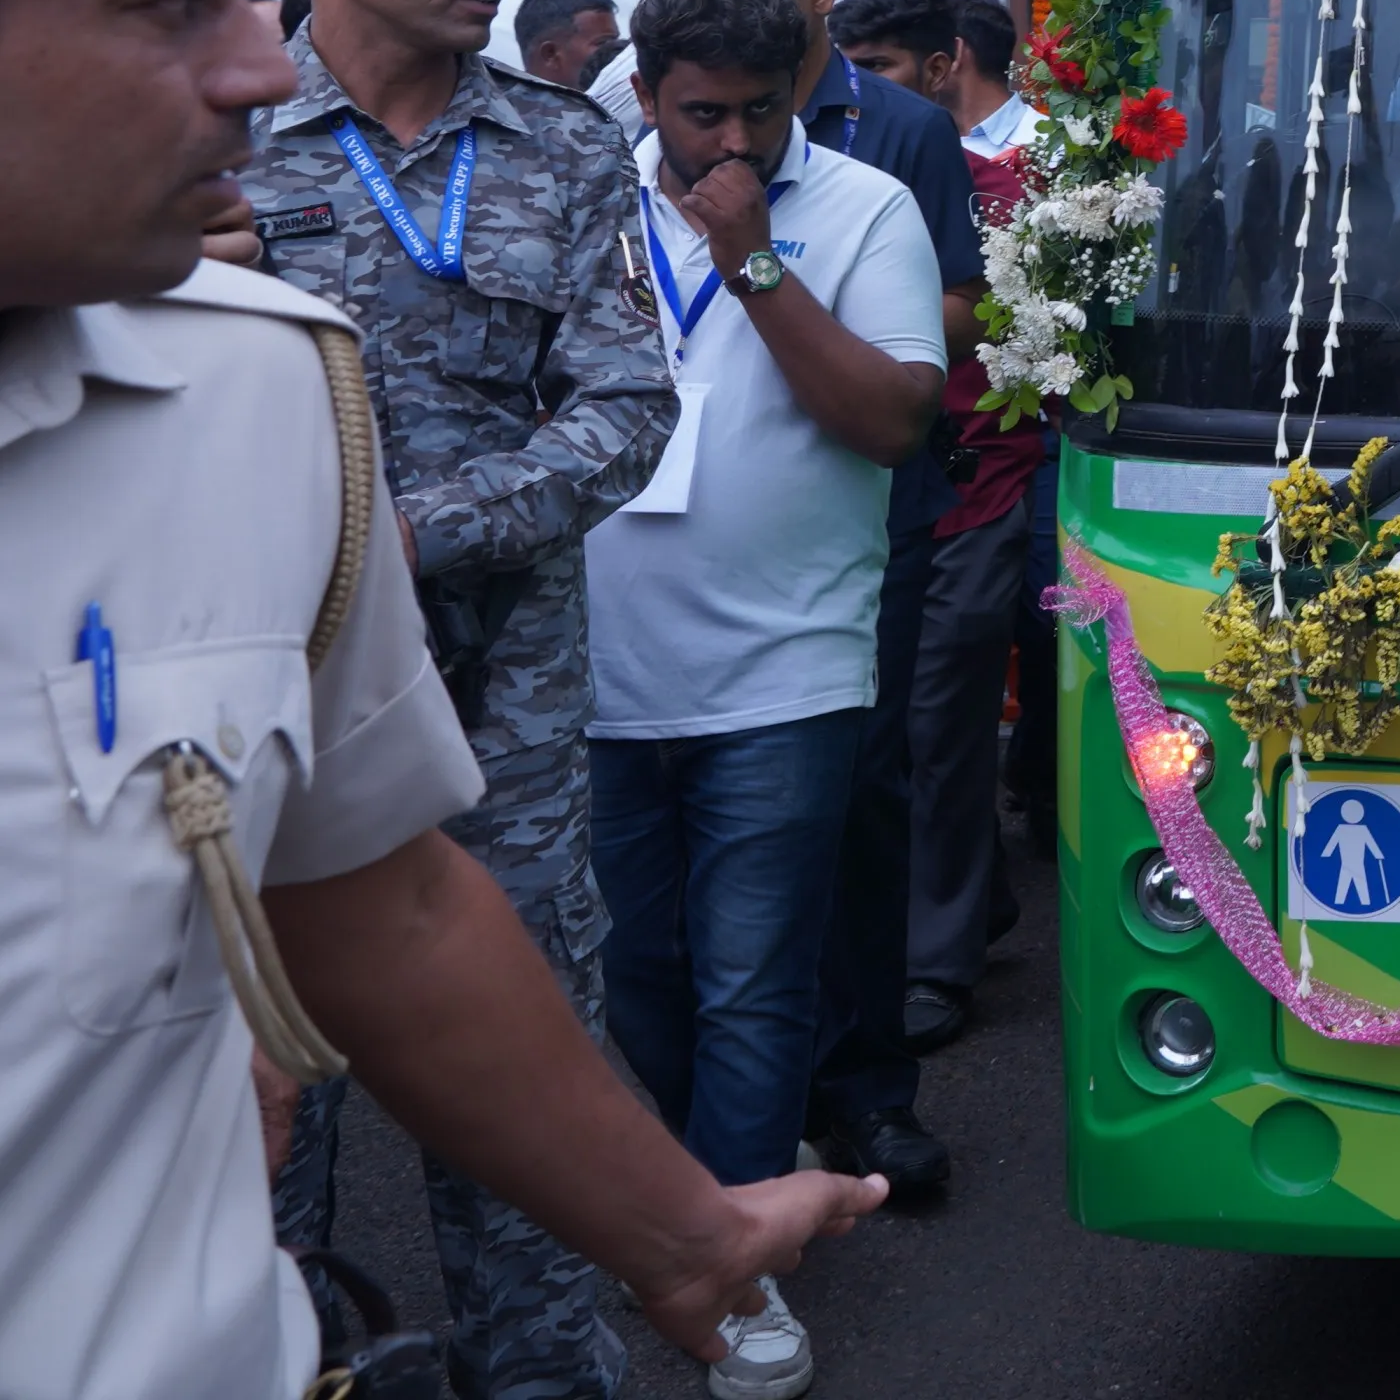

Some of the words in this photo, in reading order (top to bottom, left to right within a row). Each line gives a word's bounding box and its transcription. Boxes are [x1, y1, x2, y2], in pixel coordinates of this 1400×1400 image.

[341, 134, 376, 175] (MHA)
[460, 127, 475, 160] (MHA
[368, 176, 395, 208] CRPF
[453, 162, 469, 195] CRPF
[392, 208, 427, 257] Security
[445, 197, 466, 240] Security
[421, 258, 442, 278] VIP
[443, 241, 456, 266] VIP
